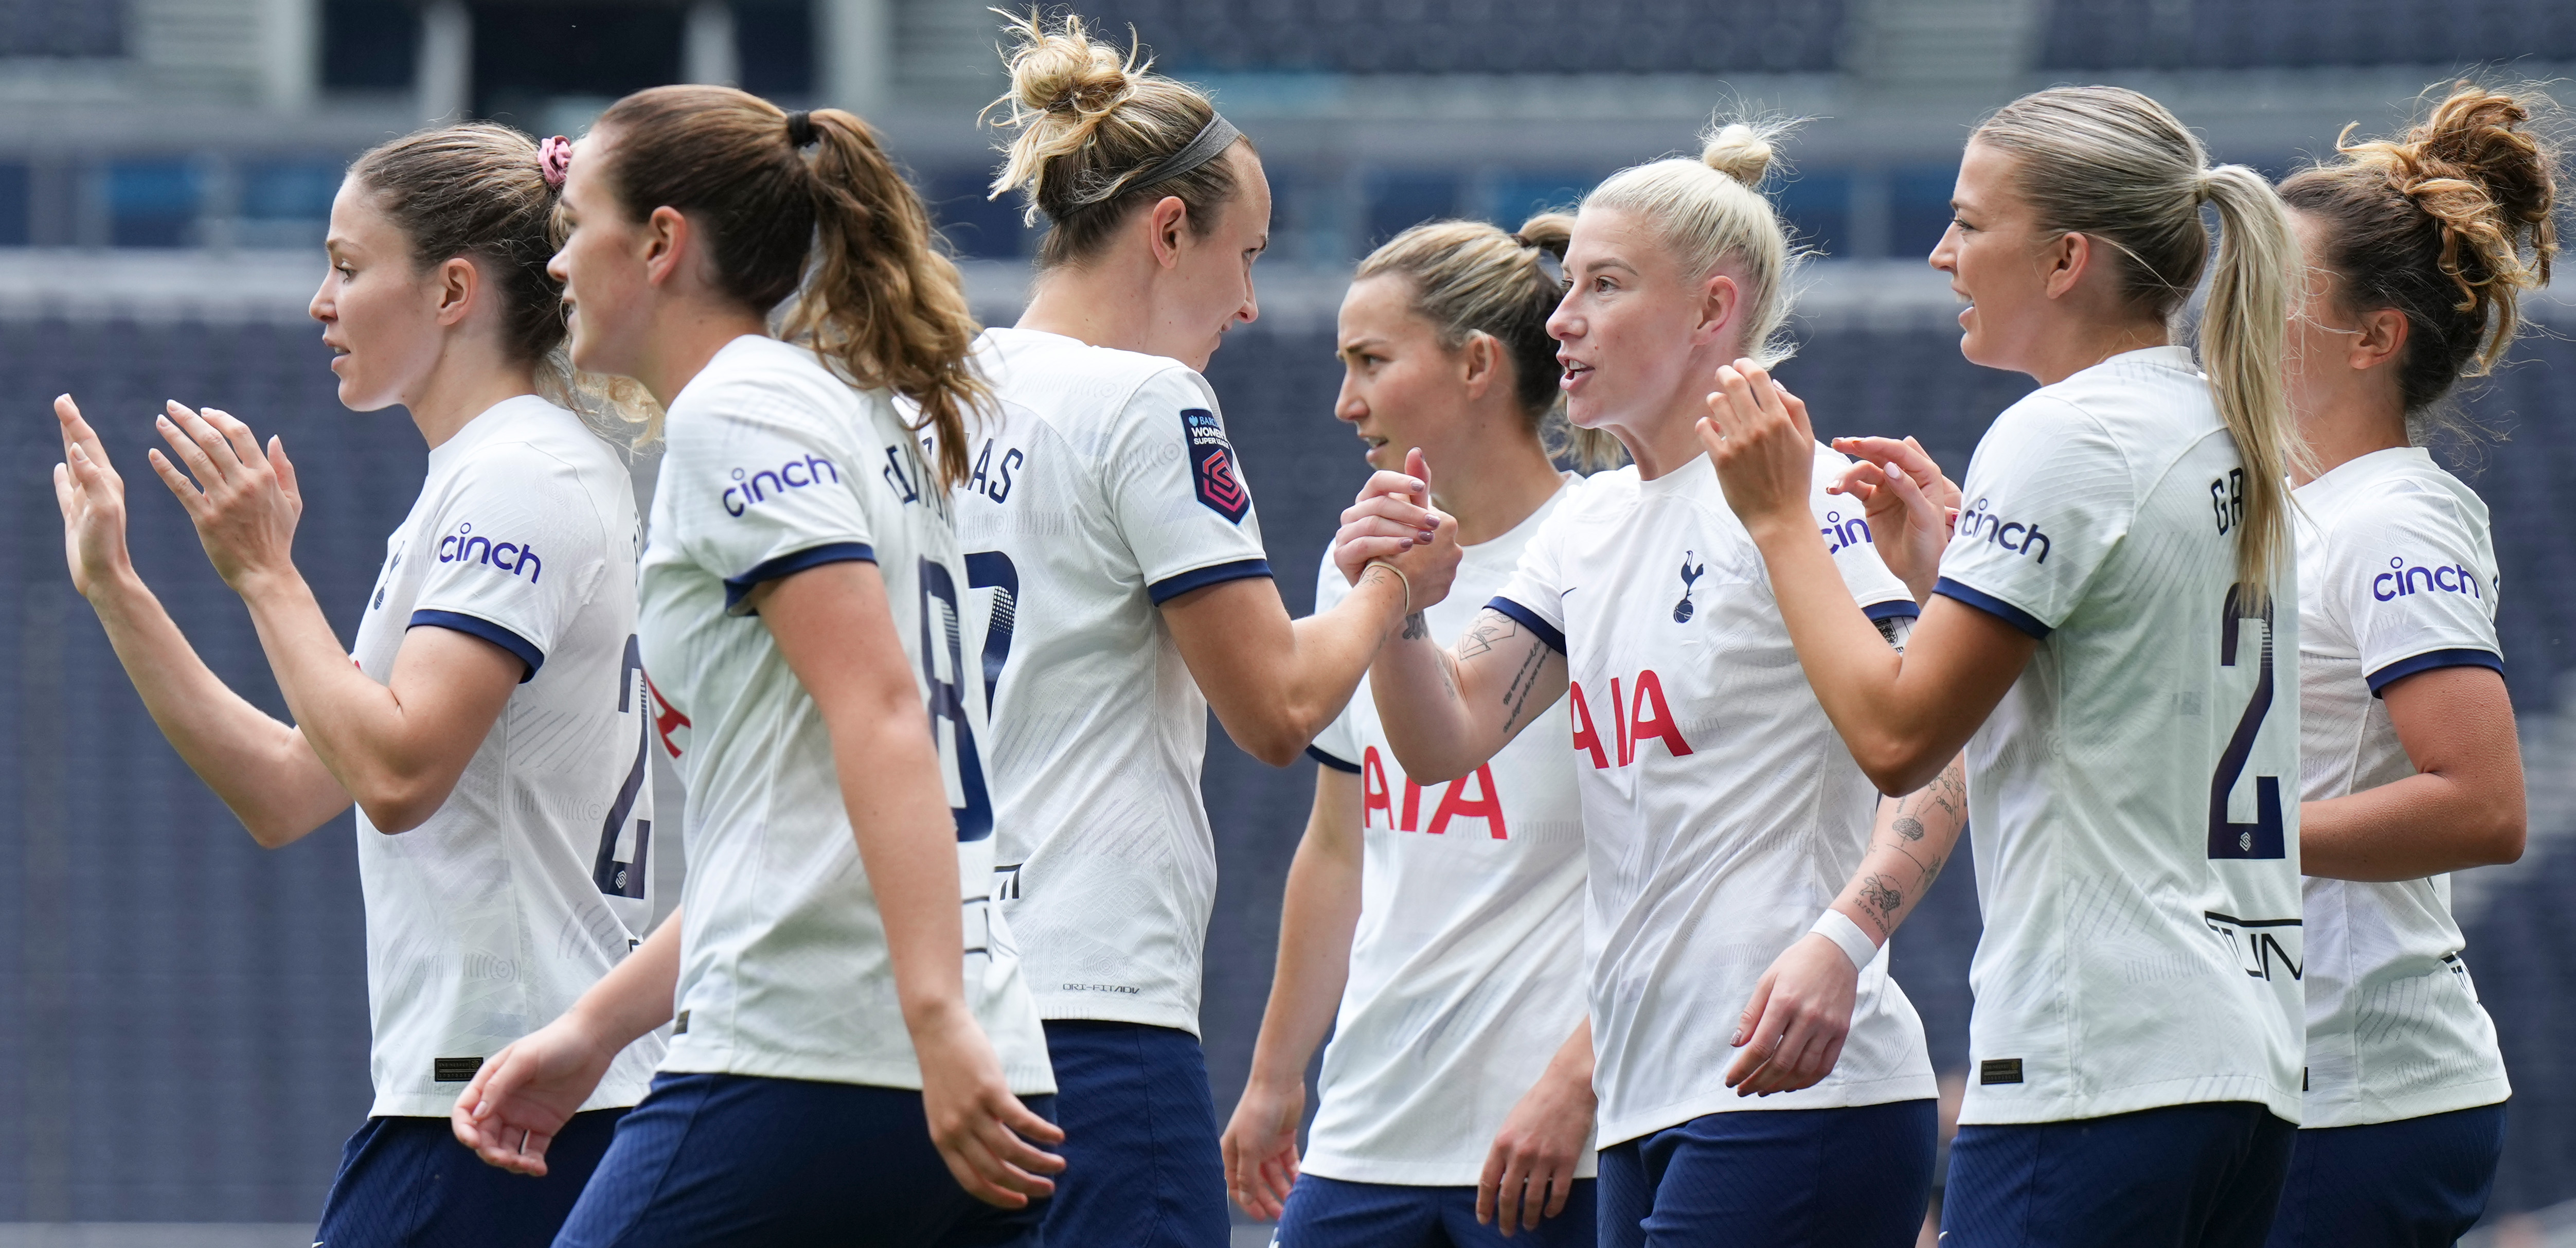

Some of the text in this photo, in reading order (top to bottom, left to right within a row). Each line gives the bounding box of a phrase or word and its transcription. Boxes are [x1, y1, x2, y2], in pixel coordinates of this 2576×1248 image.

[1194, 437, 1217, 445] SUPER
[722, 455, 838, 518] cinch
[440, 523, 541, 584] cinch
[1821, 511, 1872, 555] cin
[1961, 498, 2051, 565] cinch
[2373, 557, 2480, 602] cinch
[1570, 670, 1694, 769] AIA
[2207, 582, 2285, 860] 2
[1363, 745, 1508, 840] AIA
